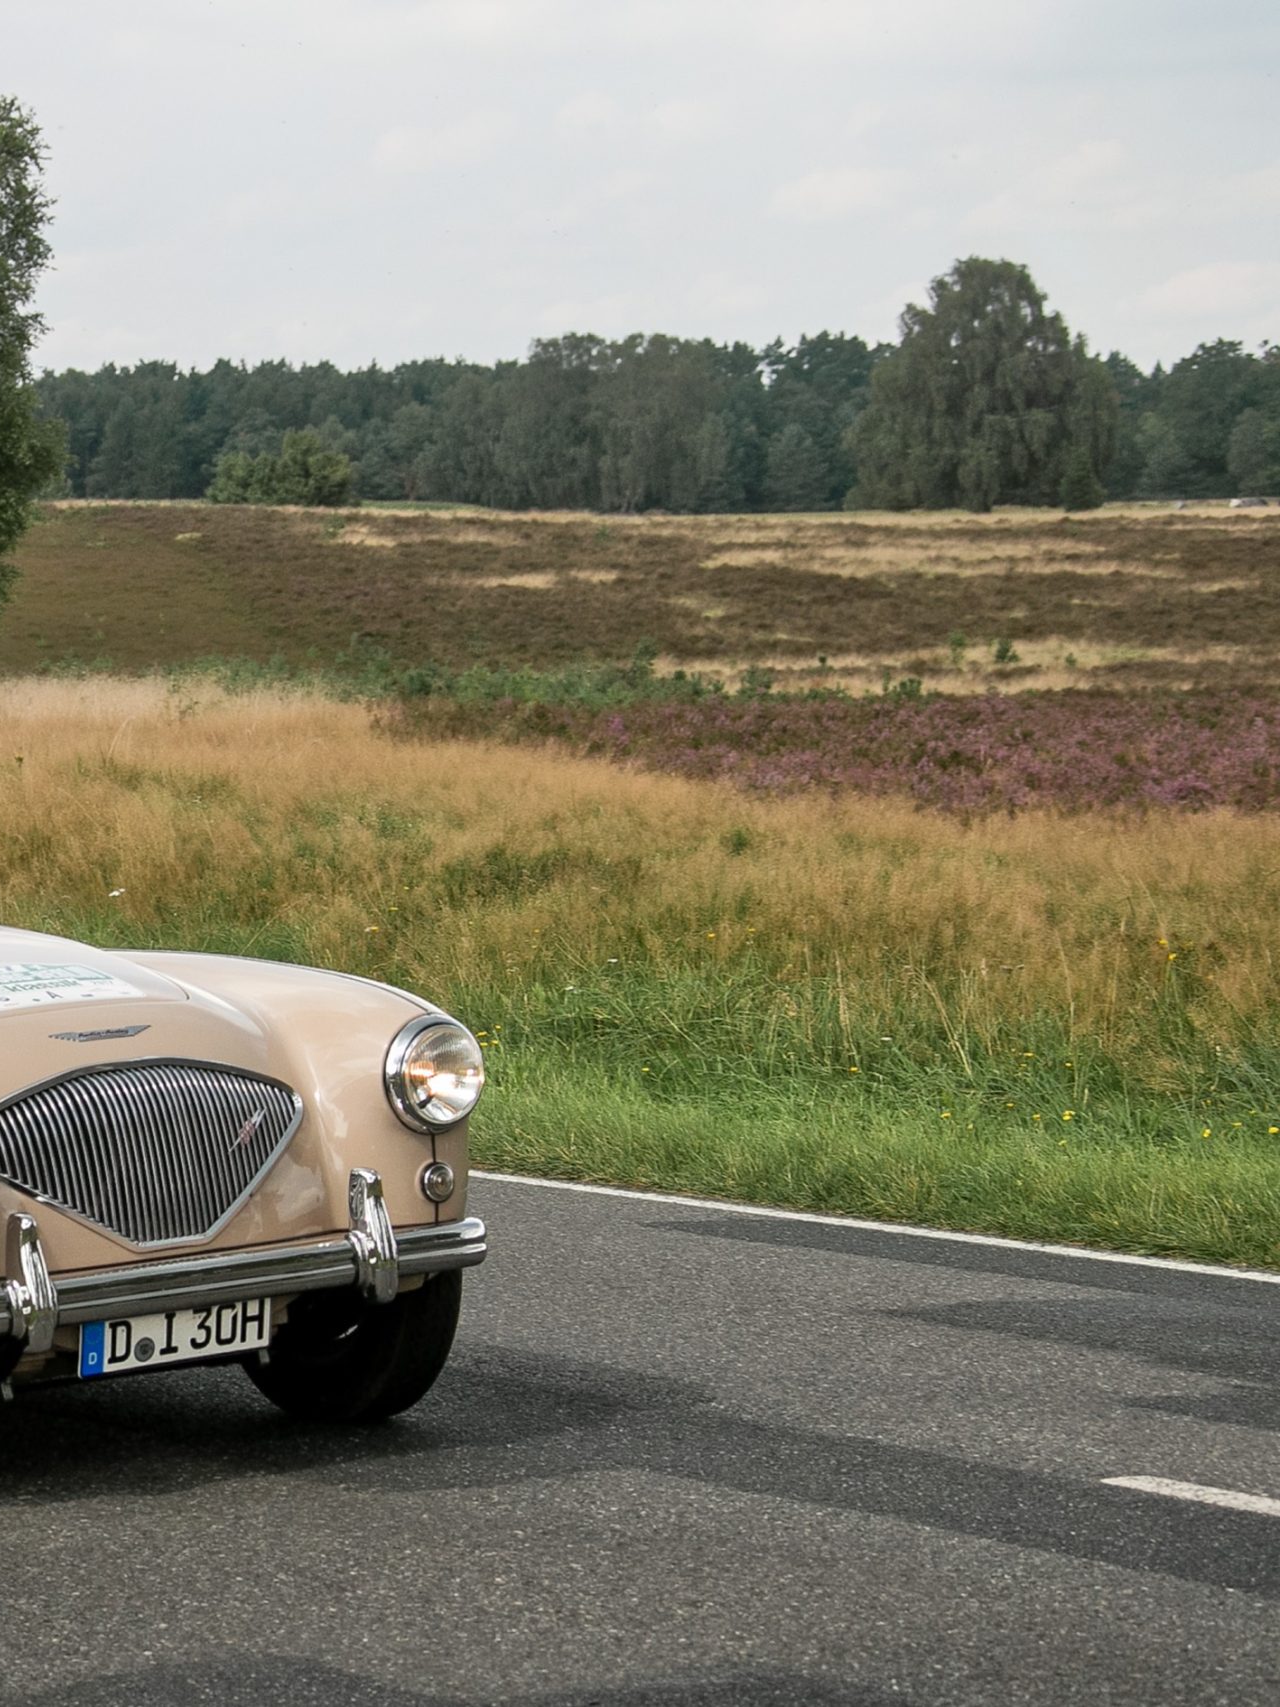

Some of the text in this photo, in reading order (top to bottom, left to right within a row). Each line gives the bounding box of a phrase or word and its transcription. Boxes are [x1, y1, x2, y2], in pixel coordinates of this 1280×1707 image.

[108, 1299, 265, 1364] D I 30H
[88, 1352, 98, 1365] D
